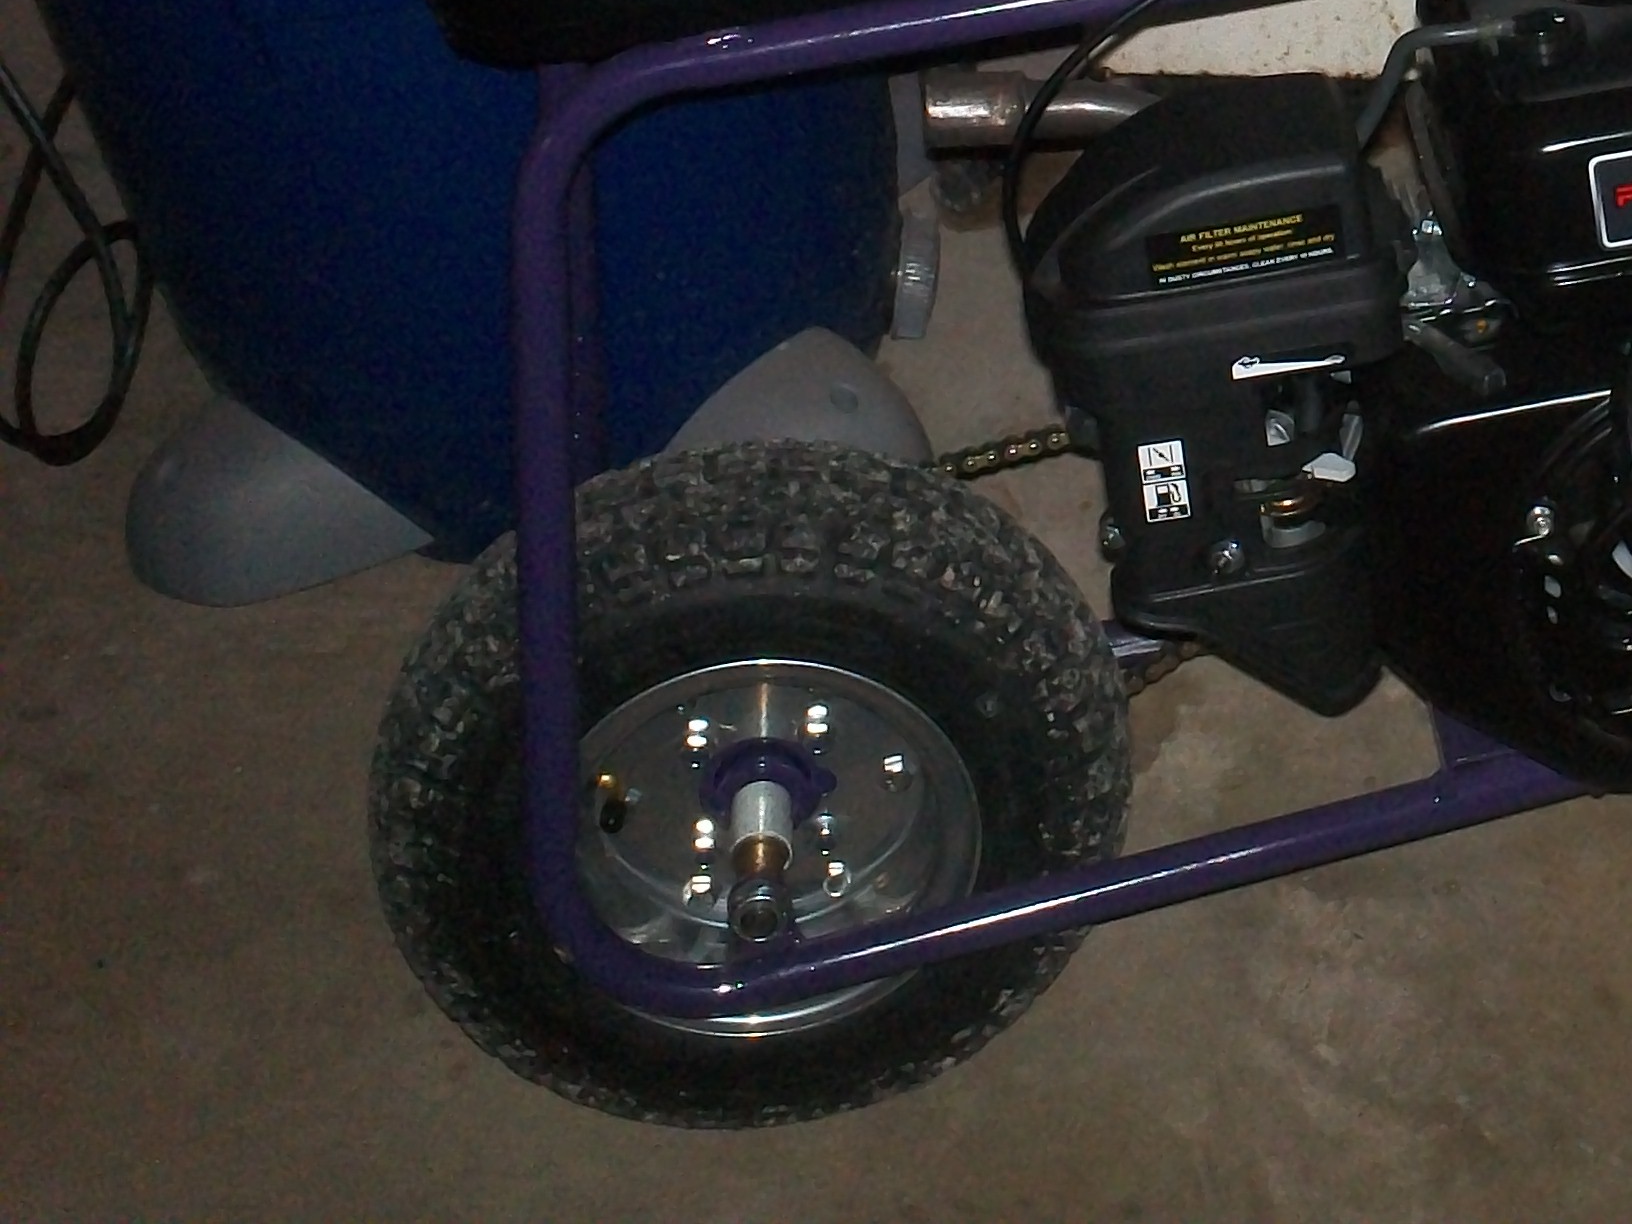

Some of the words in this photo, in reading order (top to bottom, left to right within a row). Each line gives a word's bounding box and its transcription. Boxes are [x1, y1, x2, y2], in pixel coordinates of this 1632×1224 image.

[1179, 233, 1197, 243] AIR
[1198, 227, 1232, 240] FILTER
[1233, 213, 1304, 235] MAINTENANCE
